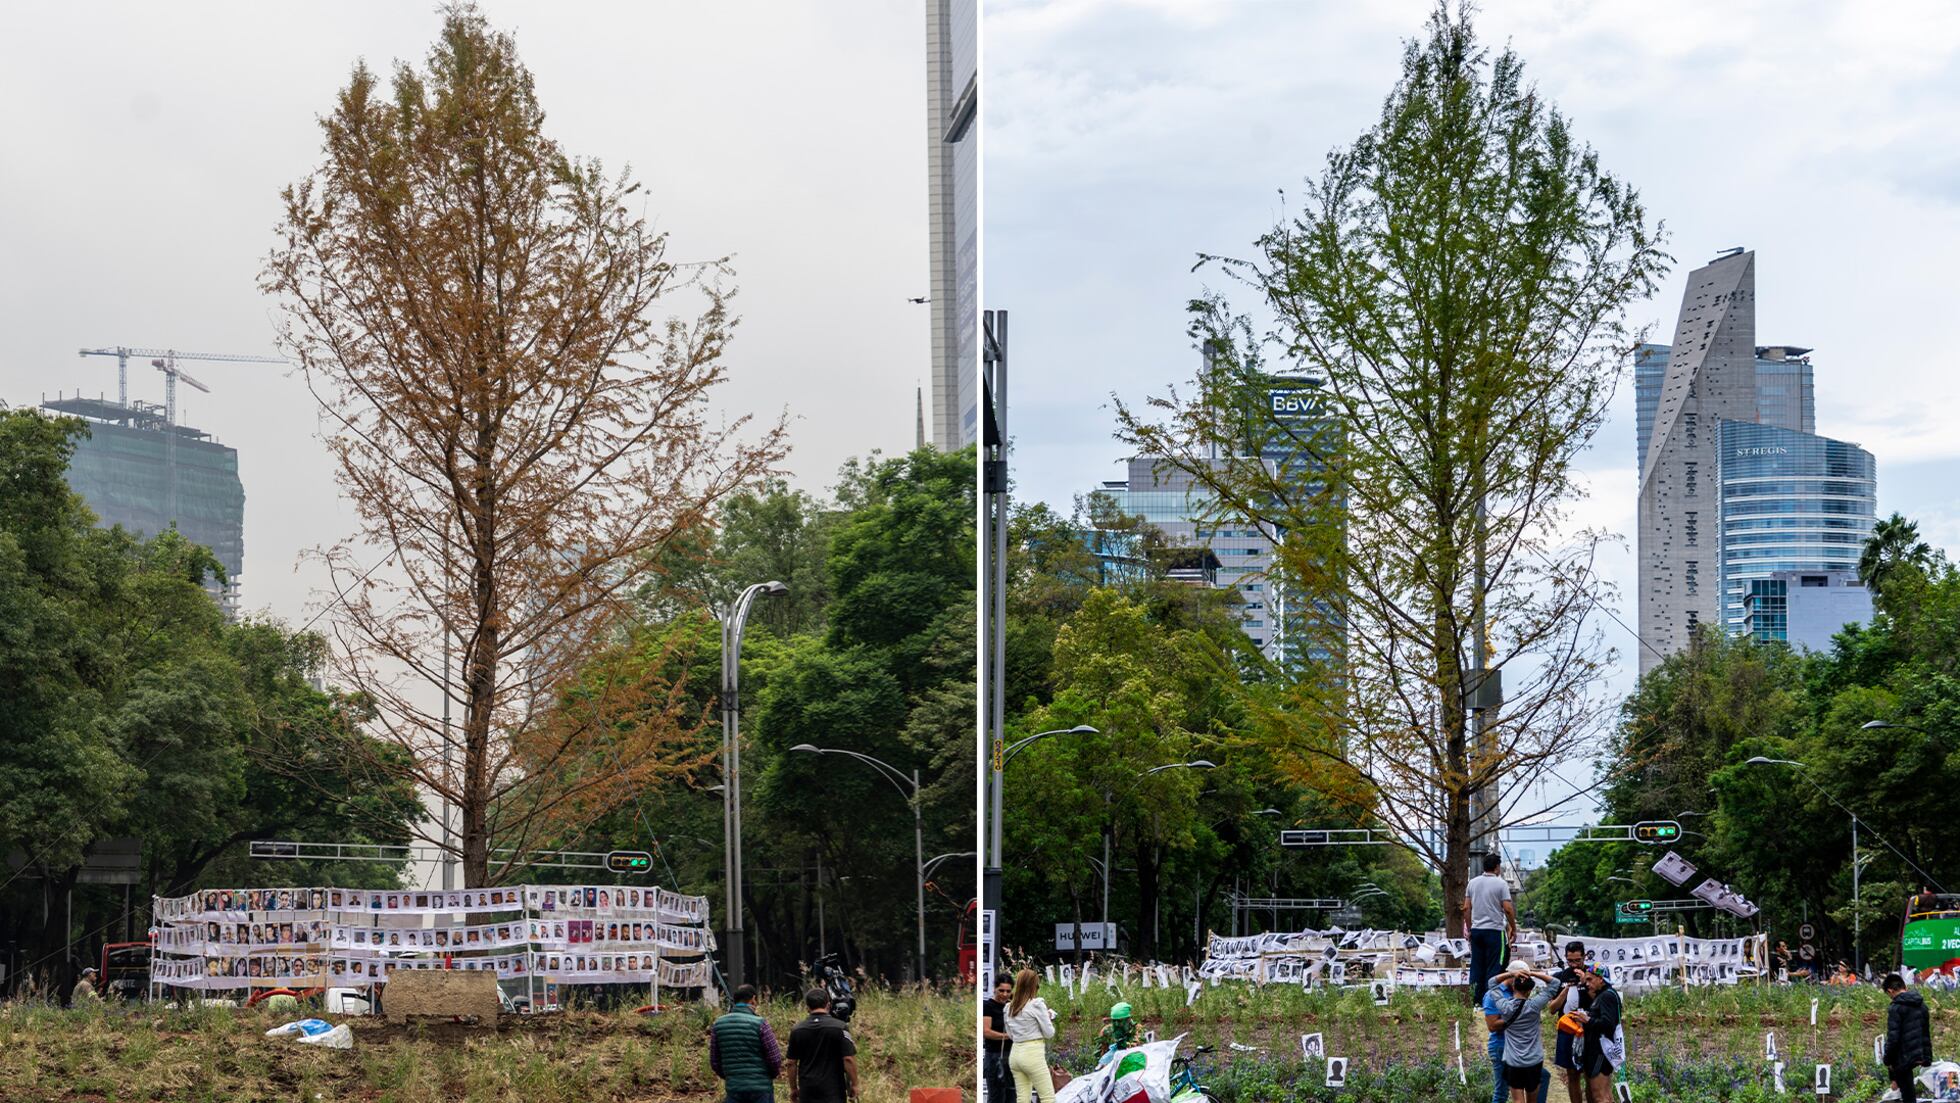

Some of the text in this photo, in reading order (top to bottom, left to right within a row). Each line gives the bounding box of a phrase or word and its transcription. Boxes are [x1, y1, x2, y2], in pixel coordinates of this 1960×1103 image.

[1273, 396, 1323, 411] BBVA
[1752, 446, 1788, 455] REGIS
[1059, 931, 1101, 941] HUWEI
